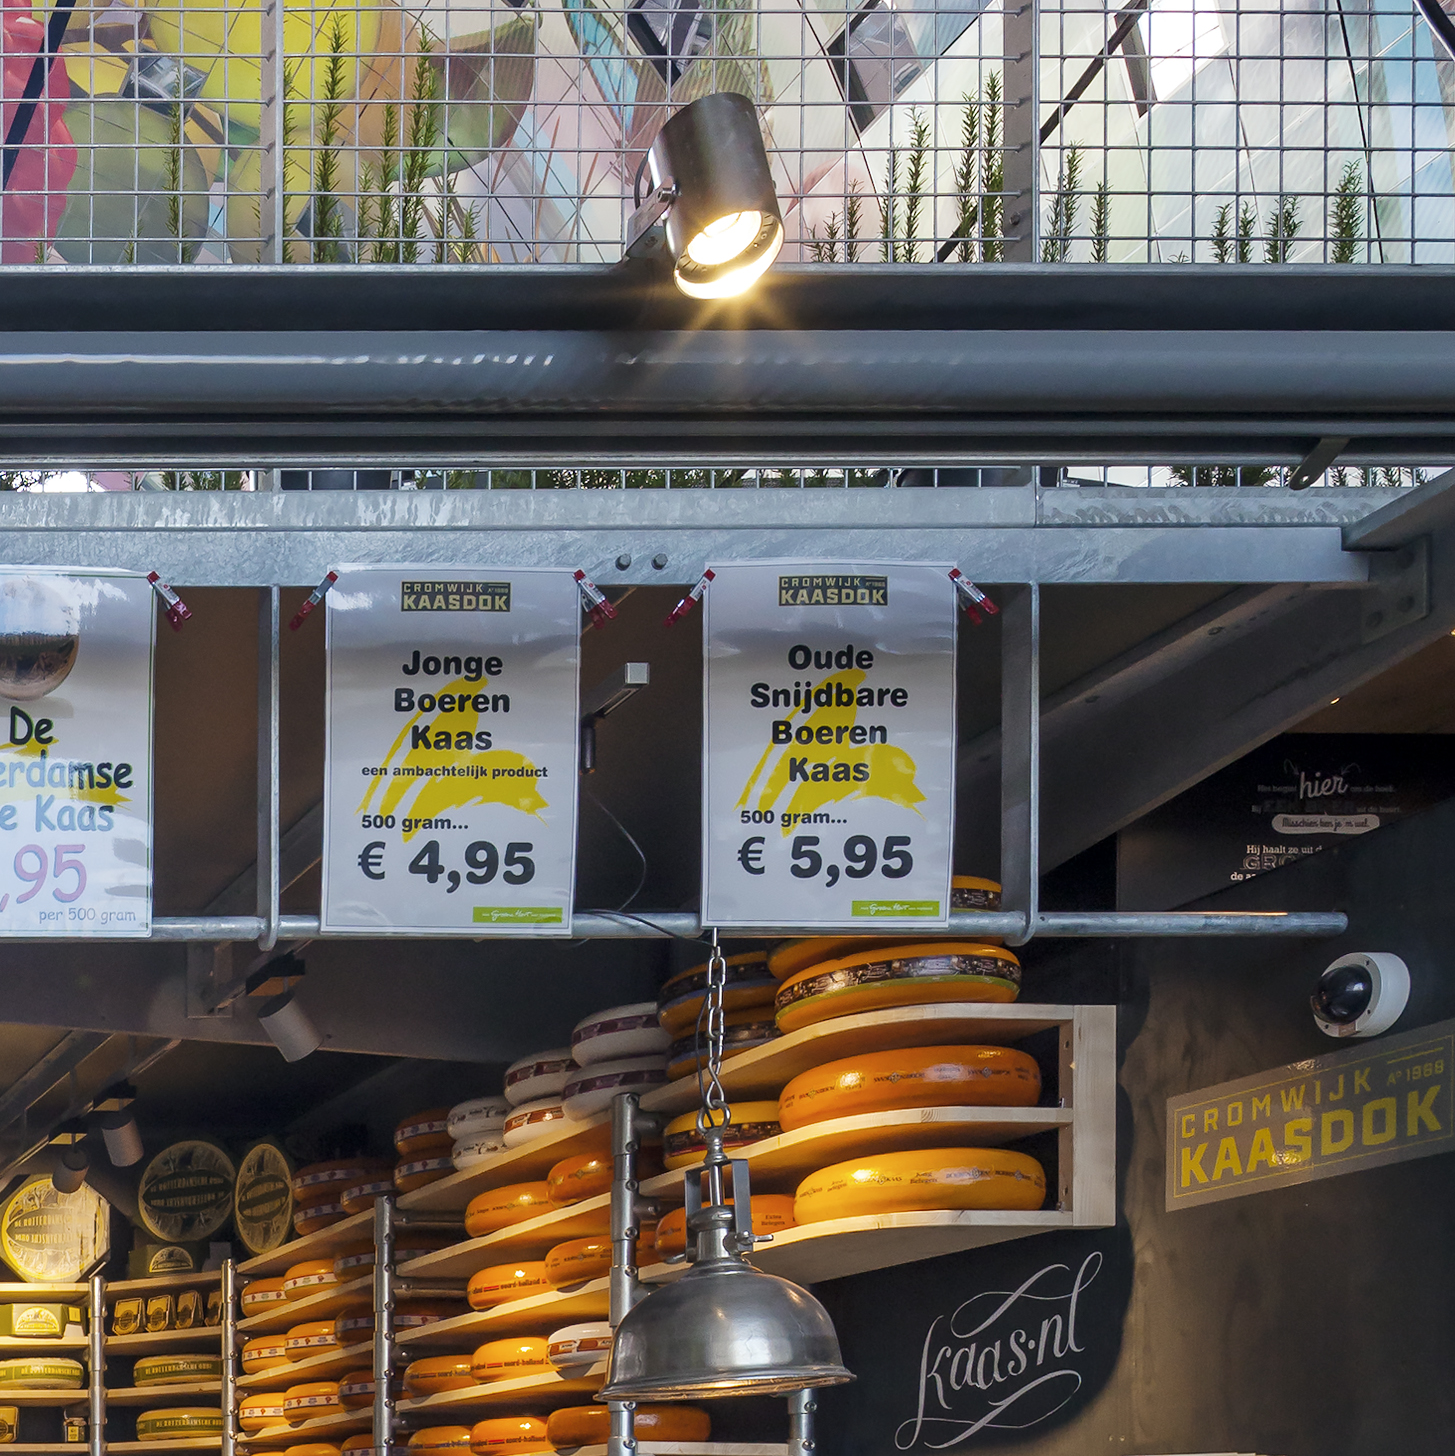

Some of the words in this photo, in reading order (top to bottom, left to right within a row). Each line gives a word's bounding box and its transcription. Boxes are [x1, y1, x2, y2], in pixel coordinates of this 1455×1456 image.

[404, 583, 483, 593] CROMWIJK
[781, 578, 861, 587] CROMWIJK
[403, 594, 508, 611] KAASDOK
[781, 589, 885, 605] KAASDOK
[402, 650, 503, 682] Jonge
[788, 645, 874, 671] Oude
[394, 688, 510, 713] Boeren
[750, 682, 908, 714] Snijdbare
[9, 706, 54, 744] De
[772, 720, 888, 745] Boeren
[411, 725, 493, 751] Kaas
[362, 767, 388, 777] een
[393, 764, 488, 779] ambachtelijk
[492, 766, 548, 779] product
[789, 757, 870, 782] Kaas
[1299, 771, 1348, 799] hier
[35, 794, 114, 832] Kaas
[361, 815, 395, 829] 500
[741, 811, 774, 824] 500
[737, 836, 765, 875] €
[790, 835, 914, 887] 5,95
[1246, 845, 1261, 856] Hij
[1262, 845, 1286, 854] haalt
[1301, 846, 1314, 854] uit
[358, 842, 386, 880] €
[408, 840, 535, 893] 4,95
[39, 910, 63, 924] per
[68, 907, 96, 922] 500
[101, 910, 136, 925] gram
[1181, 1066, 1372, 1139] CROMWIJK
[1180, 1085, 1442, 1188] KAASDOK
